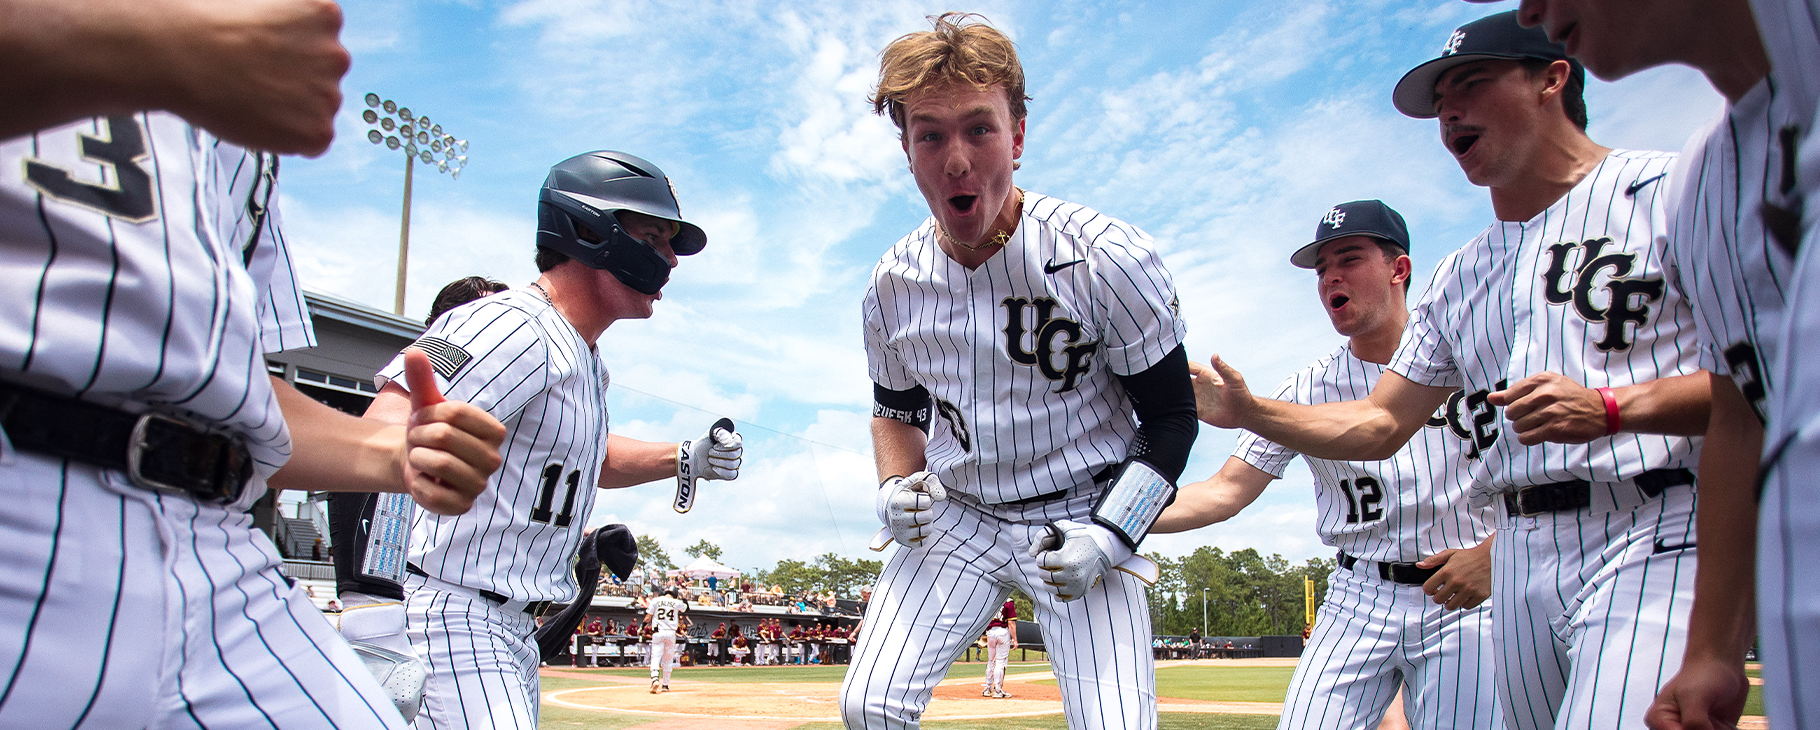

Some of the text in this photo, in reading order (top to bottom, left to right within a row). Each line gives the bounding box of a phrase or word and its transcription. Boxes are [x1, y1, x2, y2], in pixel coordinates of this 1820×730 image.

[1323, 207, 1346, 230] UCF
[1540, 236, 1664, 353] UCF
[1000, 296, 1100, 394] UCF
[916, 407, 927, 422] 43
[531, 463, 581, 528] 11
[677, 439, 692, 509] EASTON
[1340, 476, 1384, 524] 12
[657, 607, 675, 621] 24
